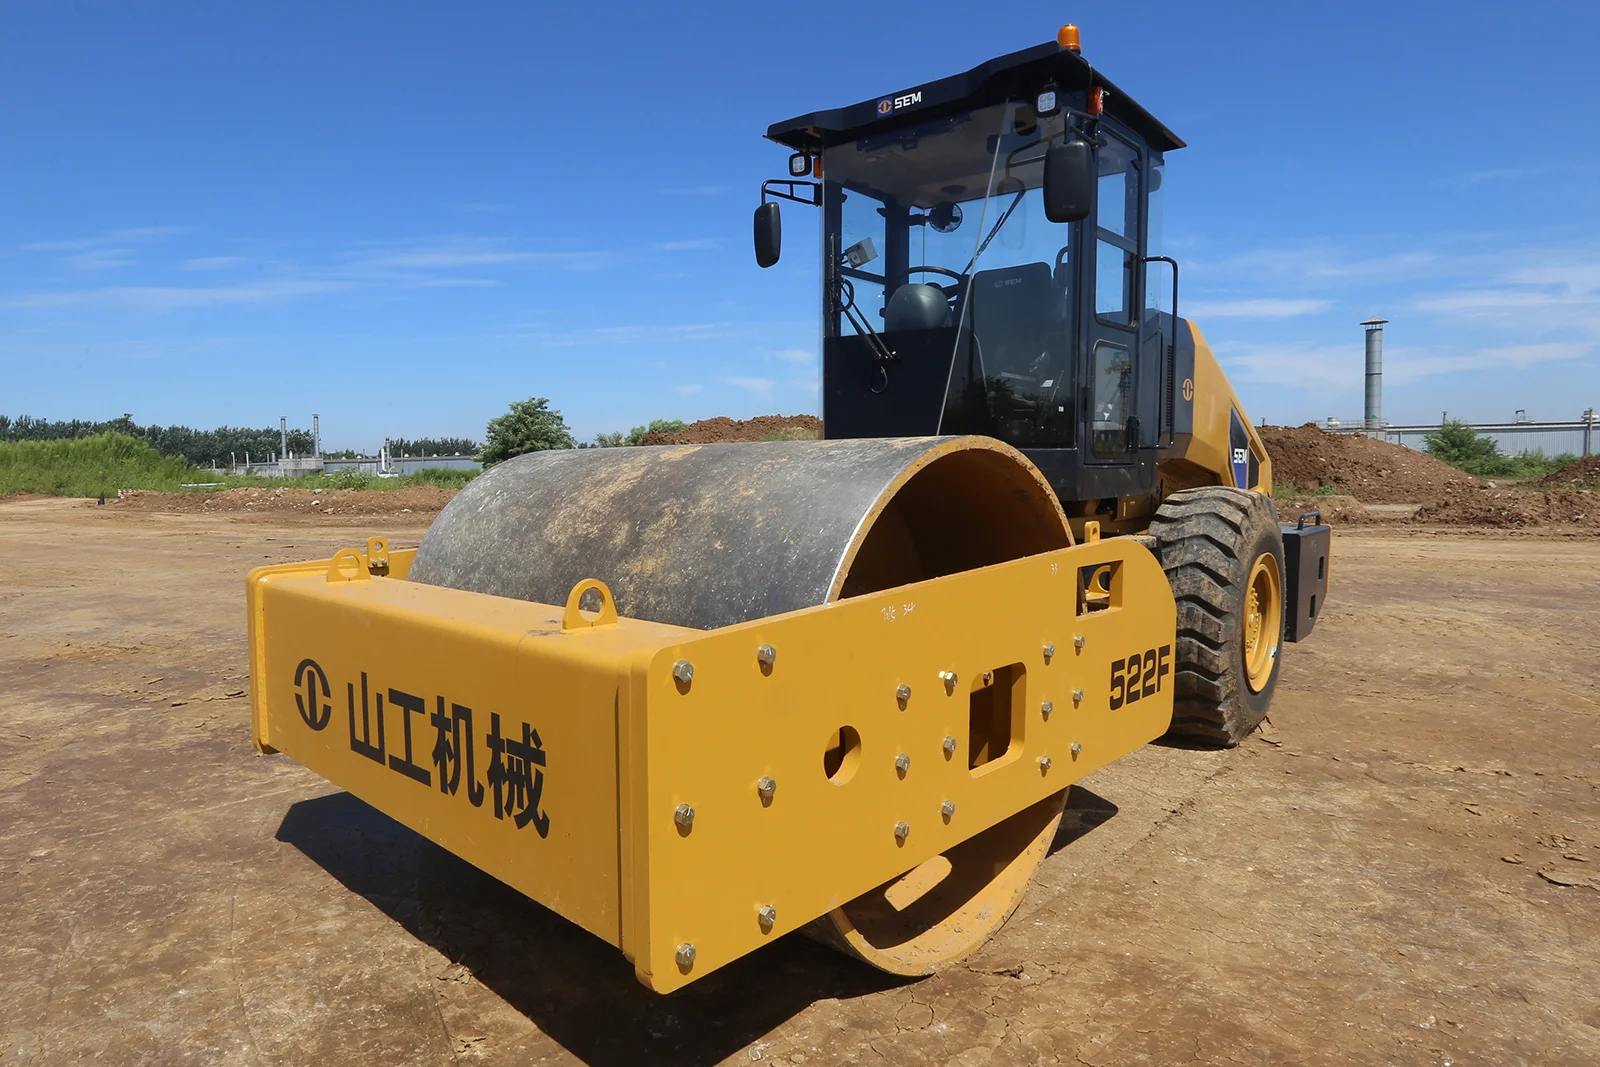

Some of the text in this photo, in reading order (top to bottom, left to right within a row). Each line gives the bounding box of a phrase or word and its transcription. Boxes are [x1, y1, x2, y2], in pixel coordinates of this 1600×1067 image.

[894, 91, 922, 110] SEM
[1233, 448, 1248, 464] SEM
[1109, 643, 1171, 711] 522F
[347, 671, 550, 839] 山工机械
